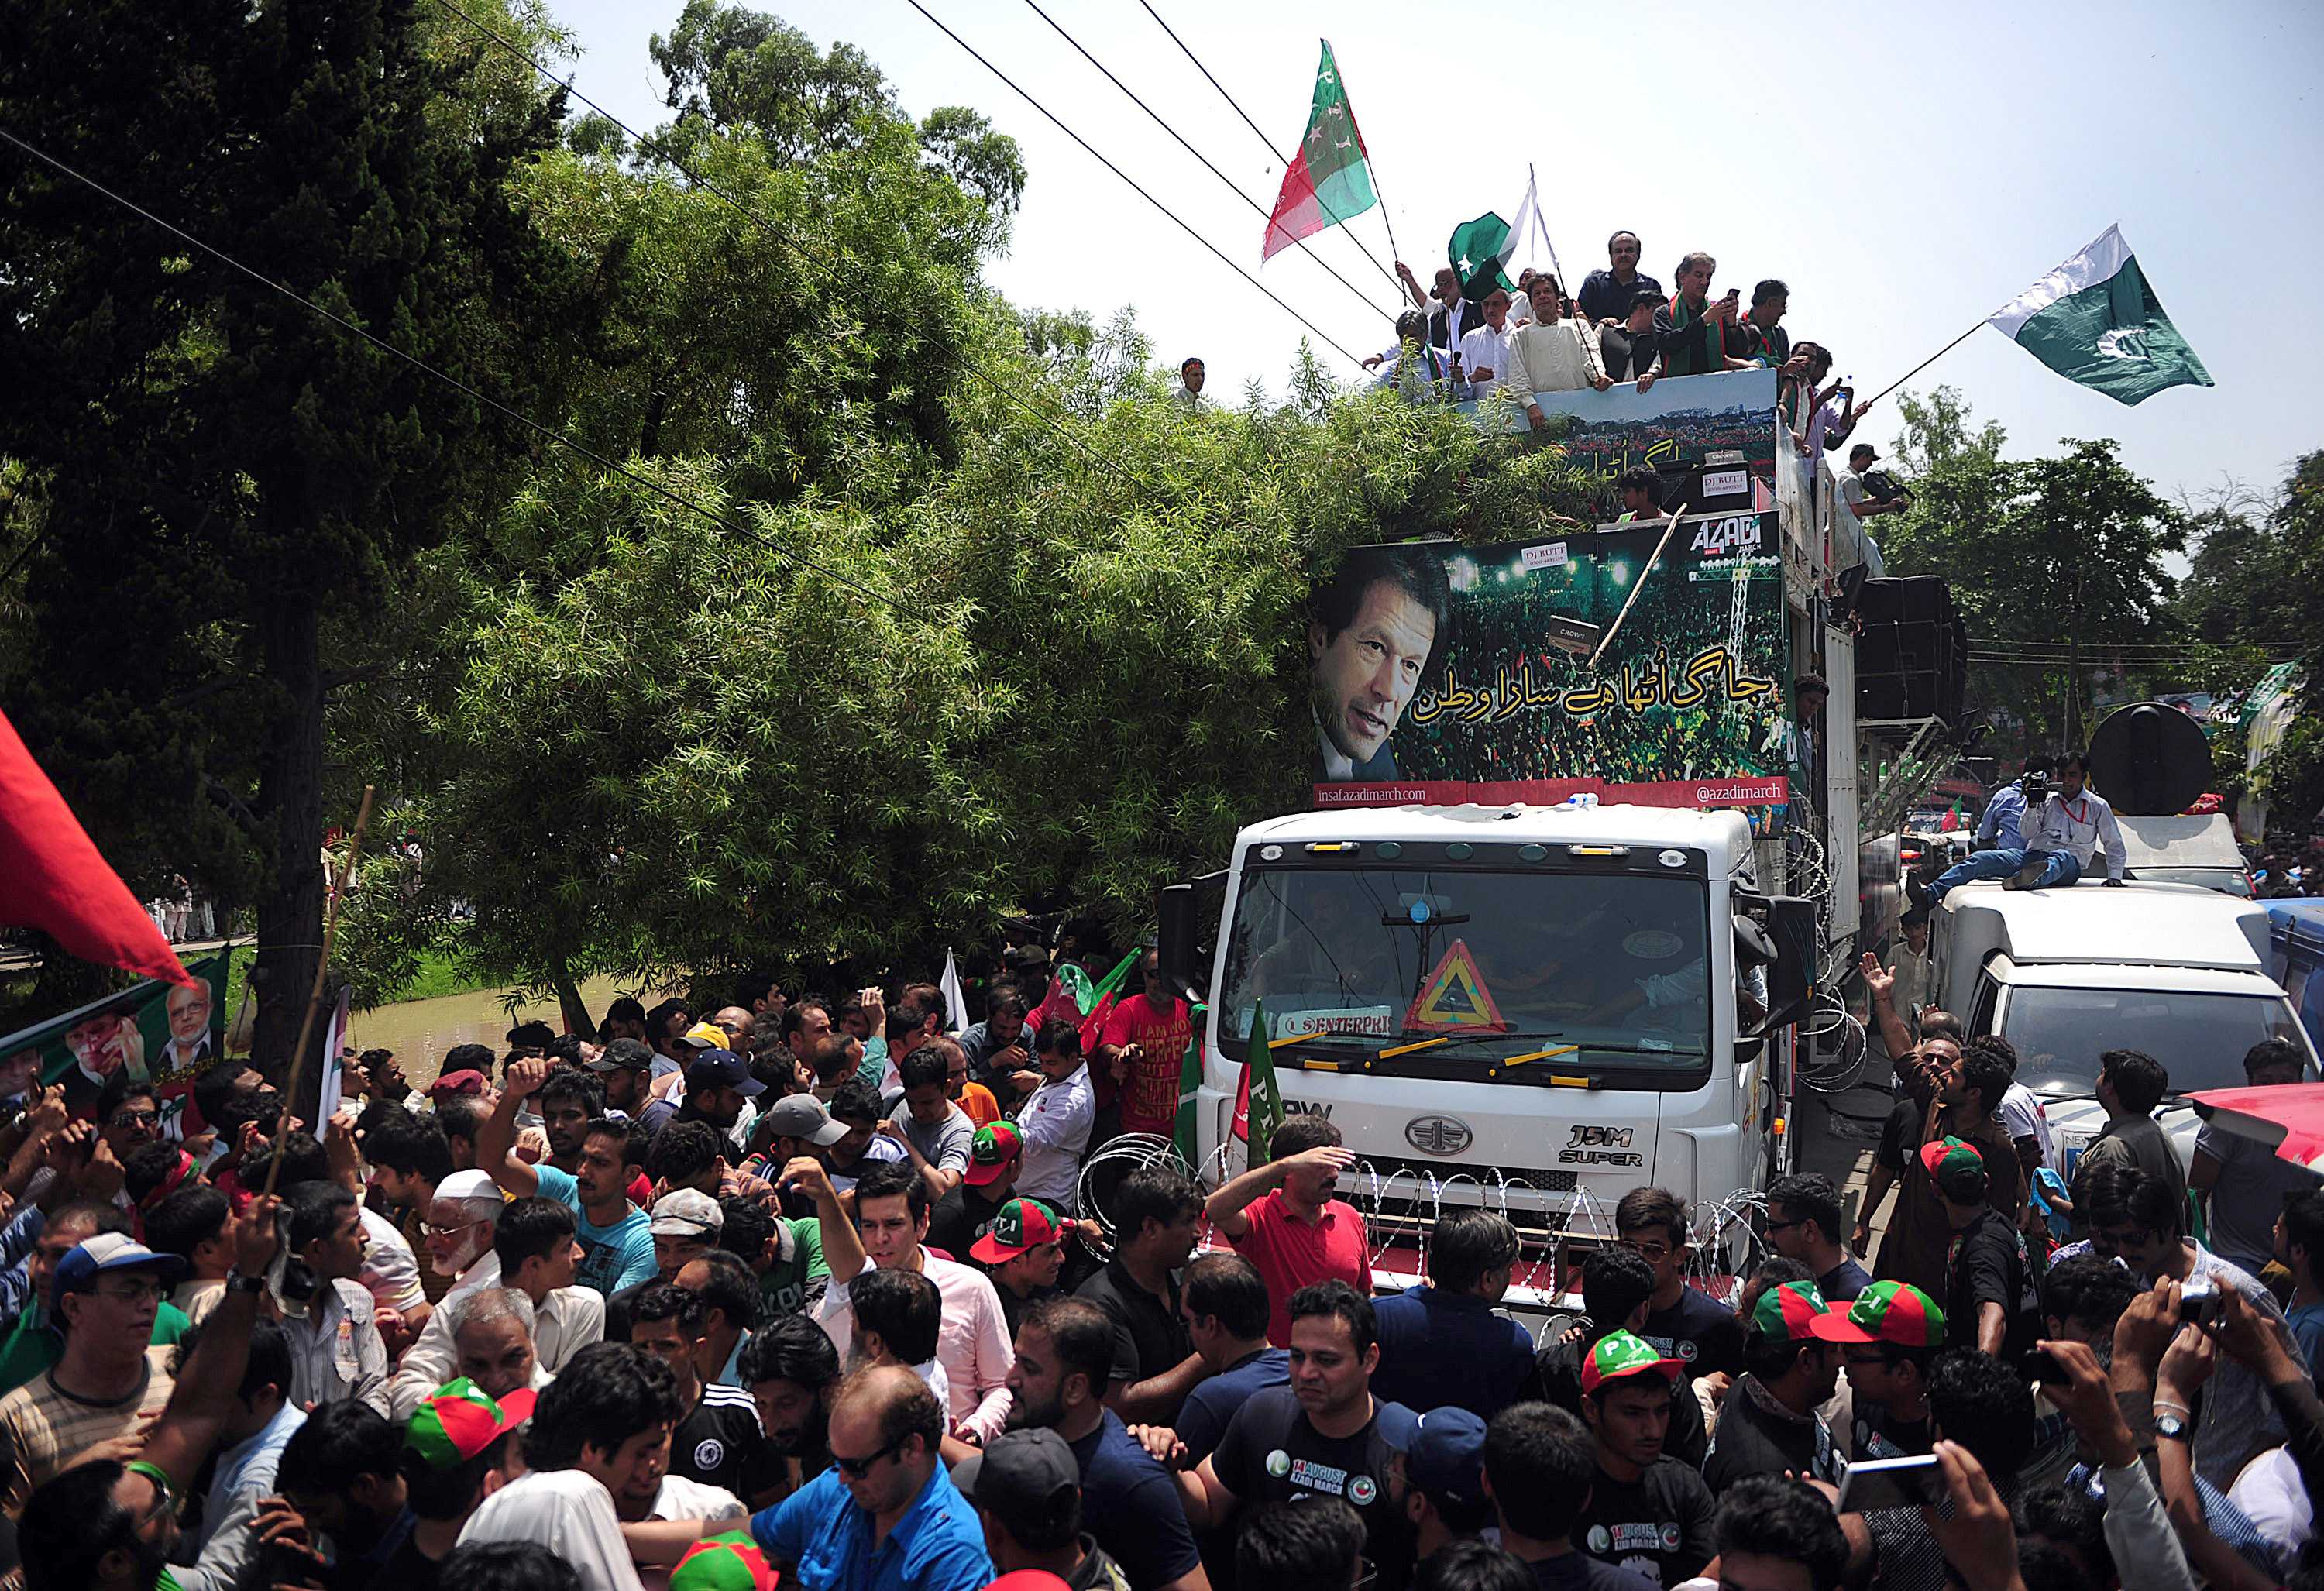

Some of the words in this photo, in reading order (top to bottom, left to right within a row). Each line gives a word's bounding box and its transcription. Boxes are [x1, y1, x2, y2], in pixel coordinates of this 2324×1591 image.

[1704, 477, 1715, 486] DJ
[1718, 474, 1745, 484] BUTT
[1690, 515, 1761, 555] AZADI
[1526, 551, 1538, 561] DJ
[1540, 545, 1566, 558] BUTT
[1739, 543, 1762, 552] MARCH
[1559, 627, 1586, 640] CROWN
[1411, 667, 1492, 723] وطن
[1493, 664, 1560, 720] سارا
[1318, 786, 1426, 802] insaf.azadimarch.com
[1697, 782, 1781, 802] @azadimarch
[1146, 1023, 1167, 1038] AM
[1566, 1125, 1634, 1149] J5M
[1559, 1149, 1643, 1167] SUPER
[1293, 1459, 1307, 1472] 14
[1305, 1462, 1347, 1484] AUGUST
[1289, 1472, 1313, 1488] AZADI
[1313, 1479, 1344, 1496] MARCH
[1630, 1537, 1660, 1550] MARCH
